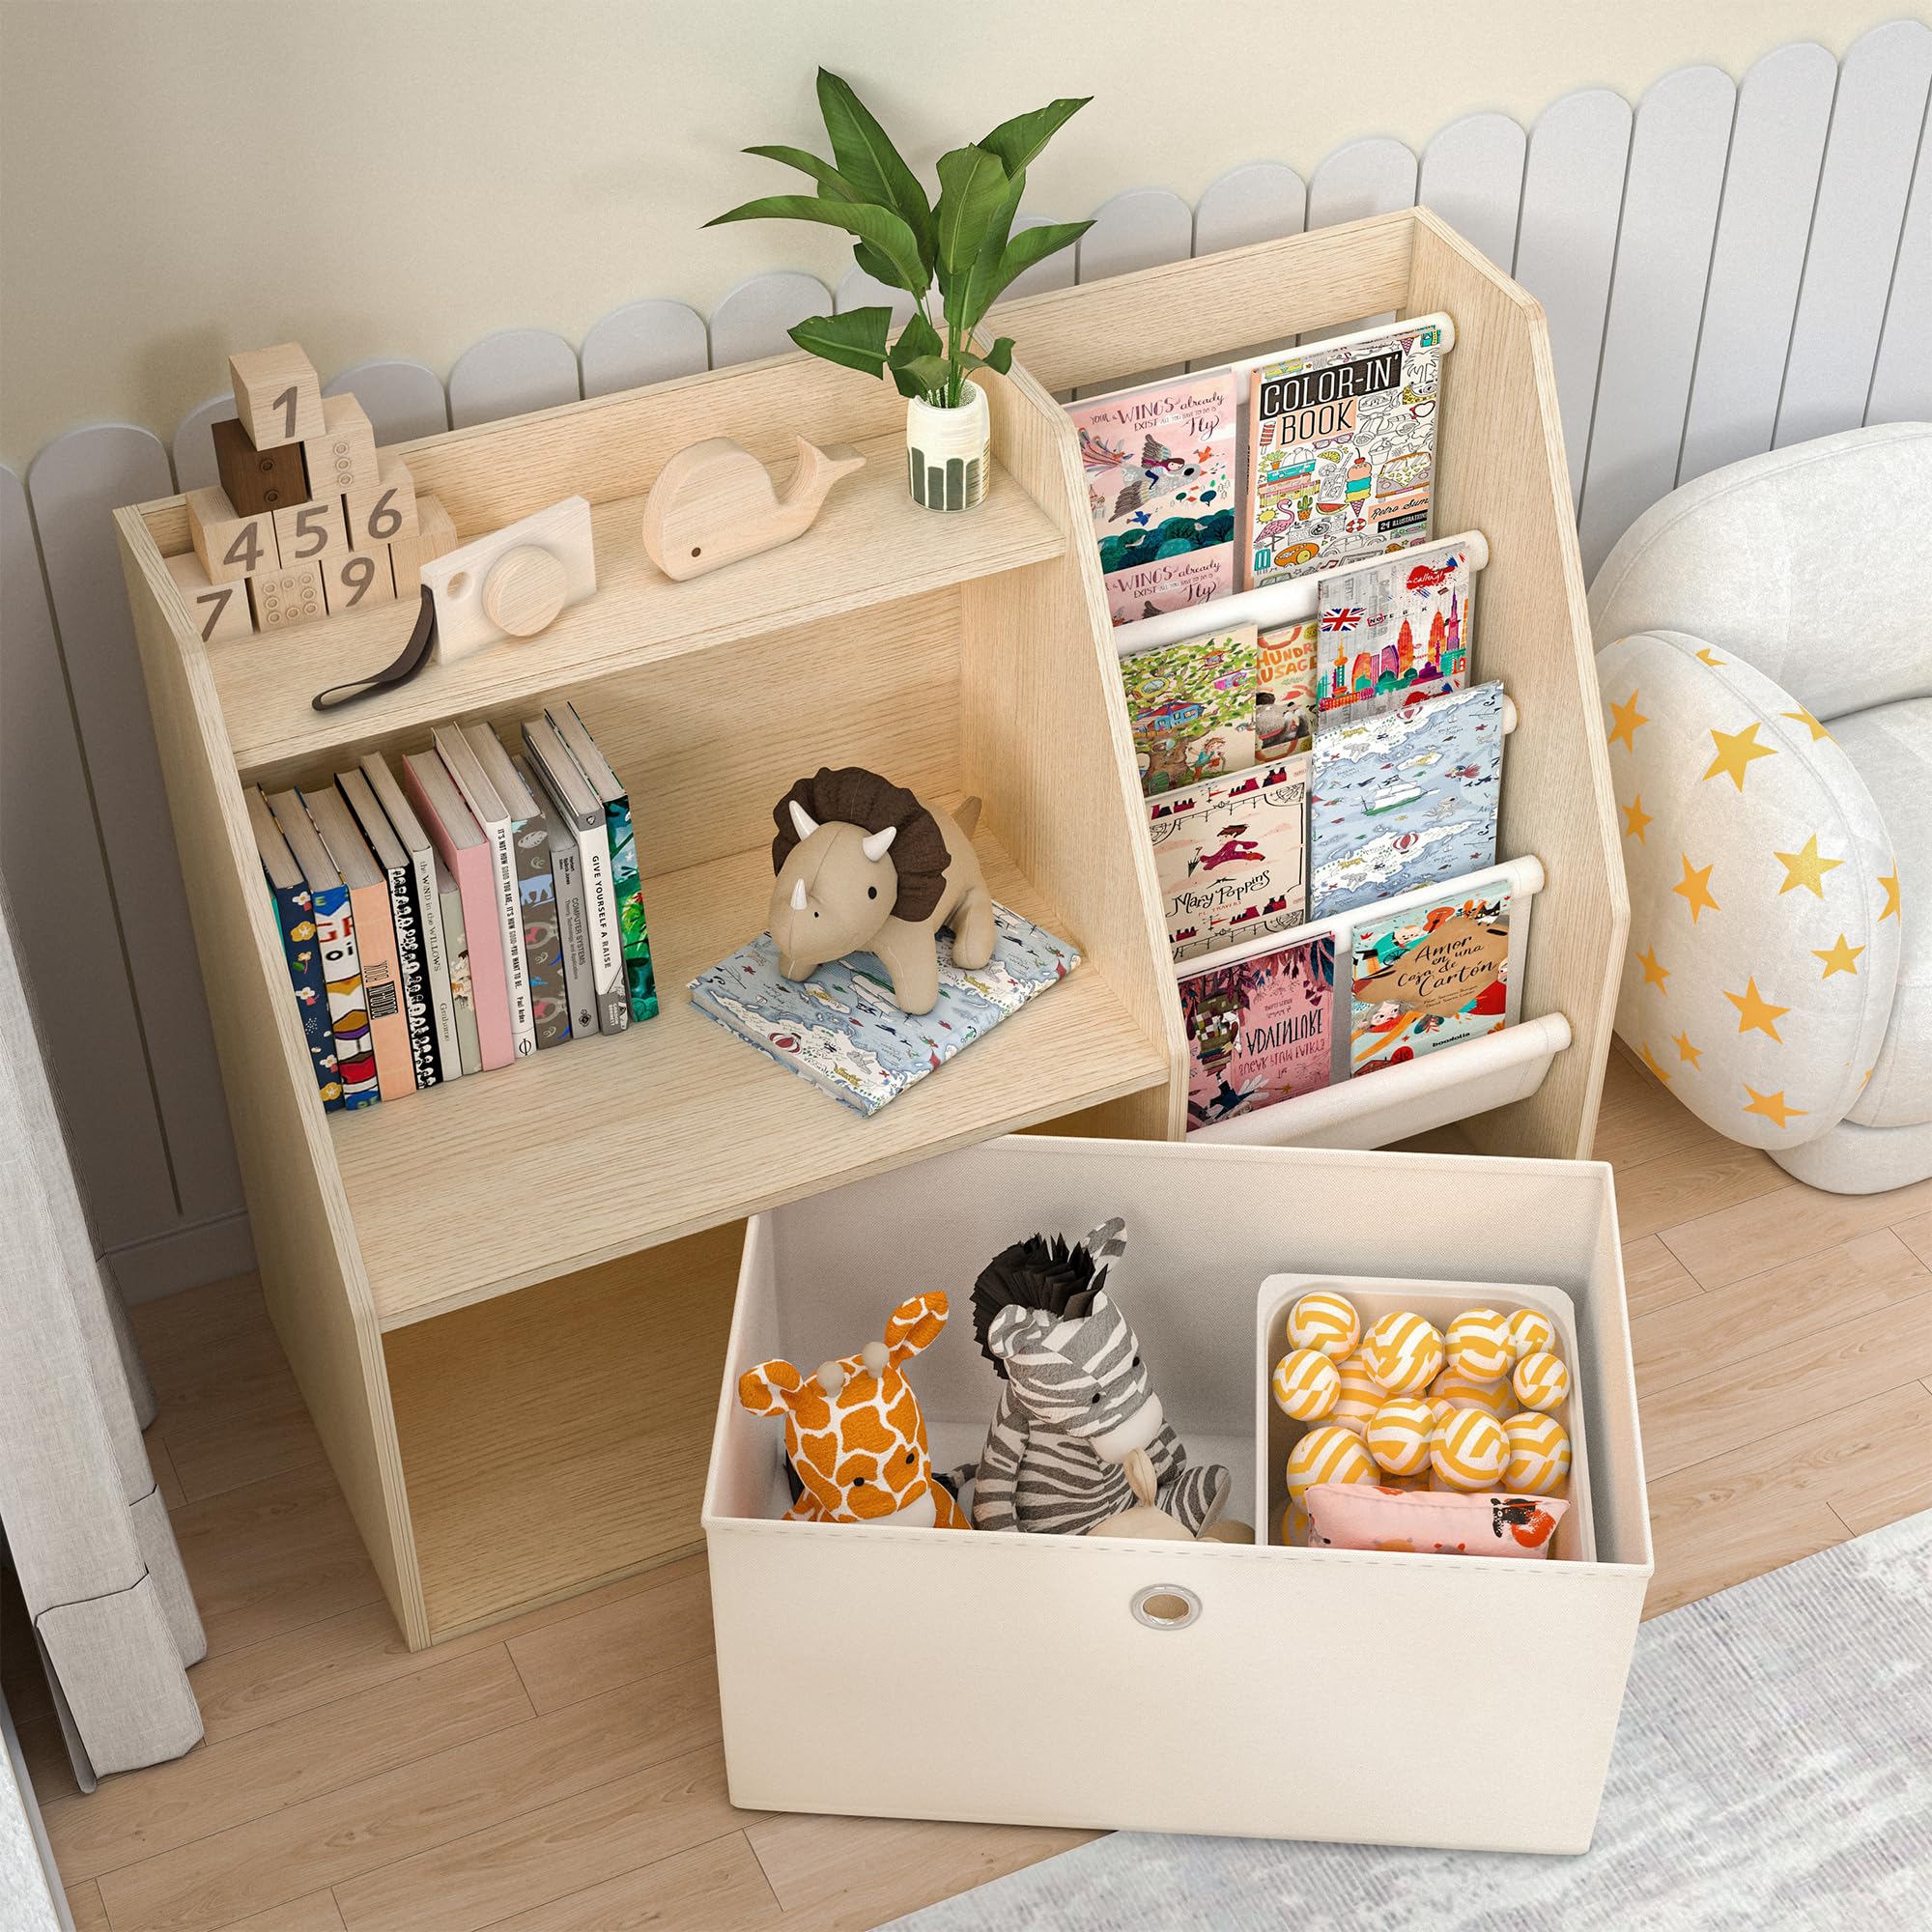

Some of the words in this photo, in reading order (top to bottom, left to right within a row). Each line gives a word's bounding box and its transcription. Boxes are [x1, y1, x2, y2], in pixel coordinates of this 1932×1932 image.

[272, 385, 298, 439] 1
[1117, 396, 1176, 424] WINGS
[1179, 391, 1224, 411] already
[1134, 417, 1158, 432] EXIST
[1183, 414, 1220, 440] Fly
[1280, 399, 1353, 445] BOOK
[367, 488, 403, 539] 6
[1371, 505, 1399, 520] Retro
[1379, 521, 1391, 530] 24
[294, 504, 328, 558] 5
[223, 522, 264, 572] 4
[340, 556, 375, 608] 9
[1117, 565, 1176, 592] WINGS
[1179, 559, 1221, 578] already
[1133, 585, 1157, 598] EXIST
[1182, 581, 1217, 604] Fly
[196, 588, 233, 642] 7
[501, 866, 510, 880] GOOD
[592, 855, 601, 879] GIVE
[503, 881, 512, 893] YOU
[1165, 892, 1214, 918] Mary
[1215, 869, 1270, 904] Poppins
[572, 897, 582, 935] COMPUTER
[594, 881, 607, 928] YOURSELF
[507, 918, 516, 929] HOW
[429, 926, 440, 972] WILLOWS
[576, 935, 585, 966] SYSTEMS
[601, 940, 611, 969] RAISE
[1414, 936, 1472, 964] Amor
[1432, 955, 1448, 965] en
[1455, 945, 1485, 957] una
[364, 960, 389, 982] BOOK
[512, 957, 521, 972] WANT
[514, 972, 522, 980] TO
[1398, 970, 1434, 987] Caja
[1437, 959, 1457, 973] de
[1419, 960, 1497, 997] Cartón
